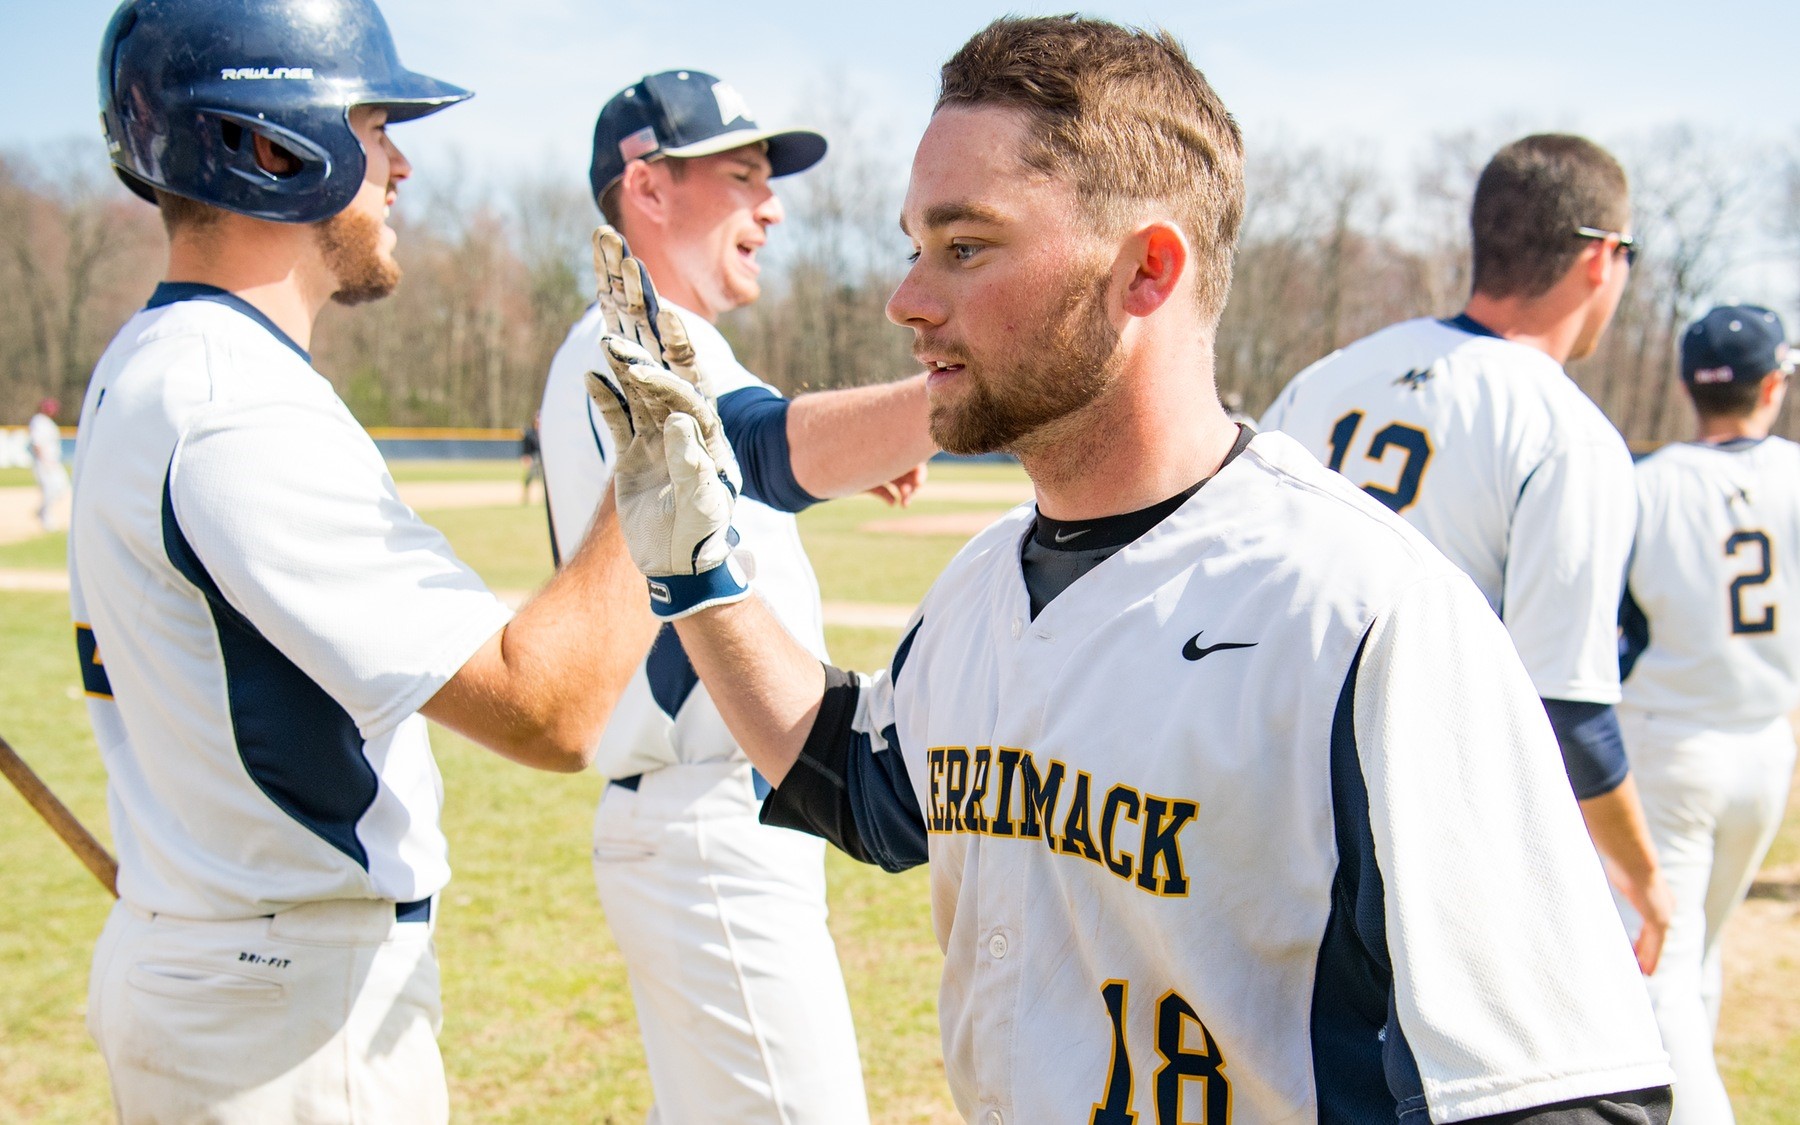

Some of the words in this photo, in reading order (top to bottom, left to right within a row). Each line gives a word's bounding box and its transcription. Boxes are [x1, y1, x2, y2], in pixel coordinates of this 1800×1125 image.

[221, 67, 314, 80] RAWLINGS
[1327, 408, 1436, 515] 12
[1722, 529, 1777, 636] 2
[927, 745, 1200, 898] ERRIMACK
[238, 951, 291, 968] DRI-FIT
[1088, 978, 1233, 1125] 18
